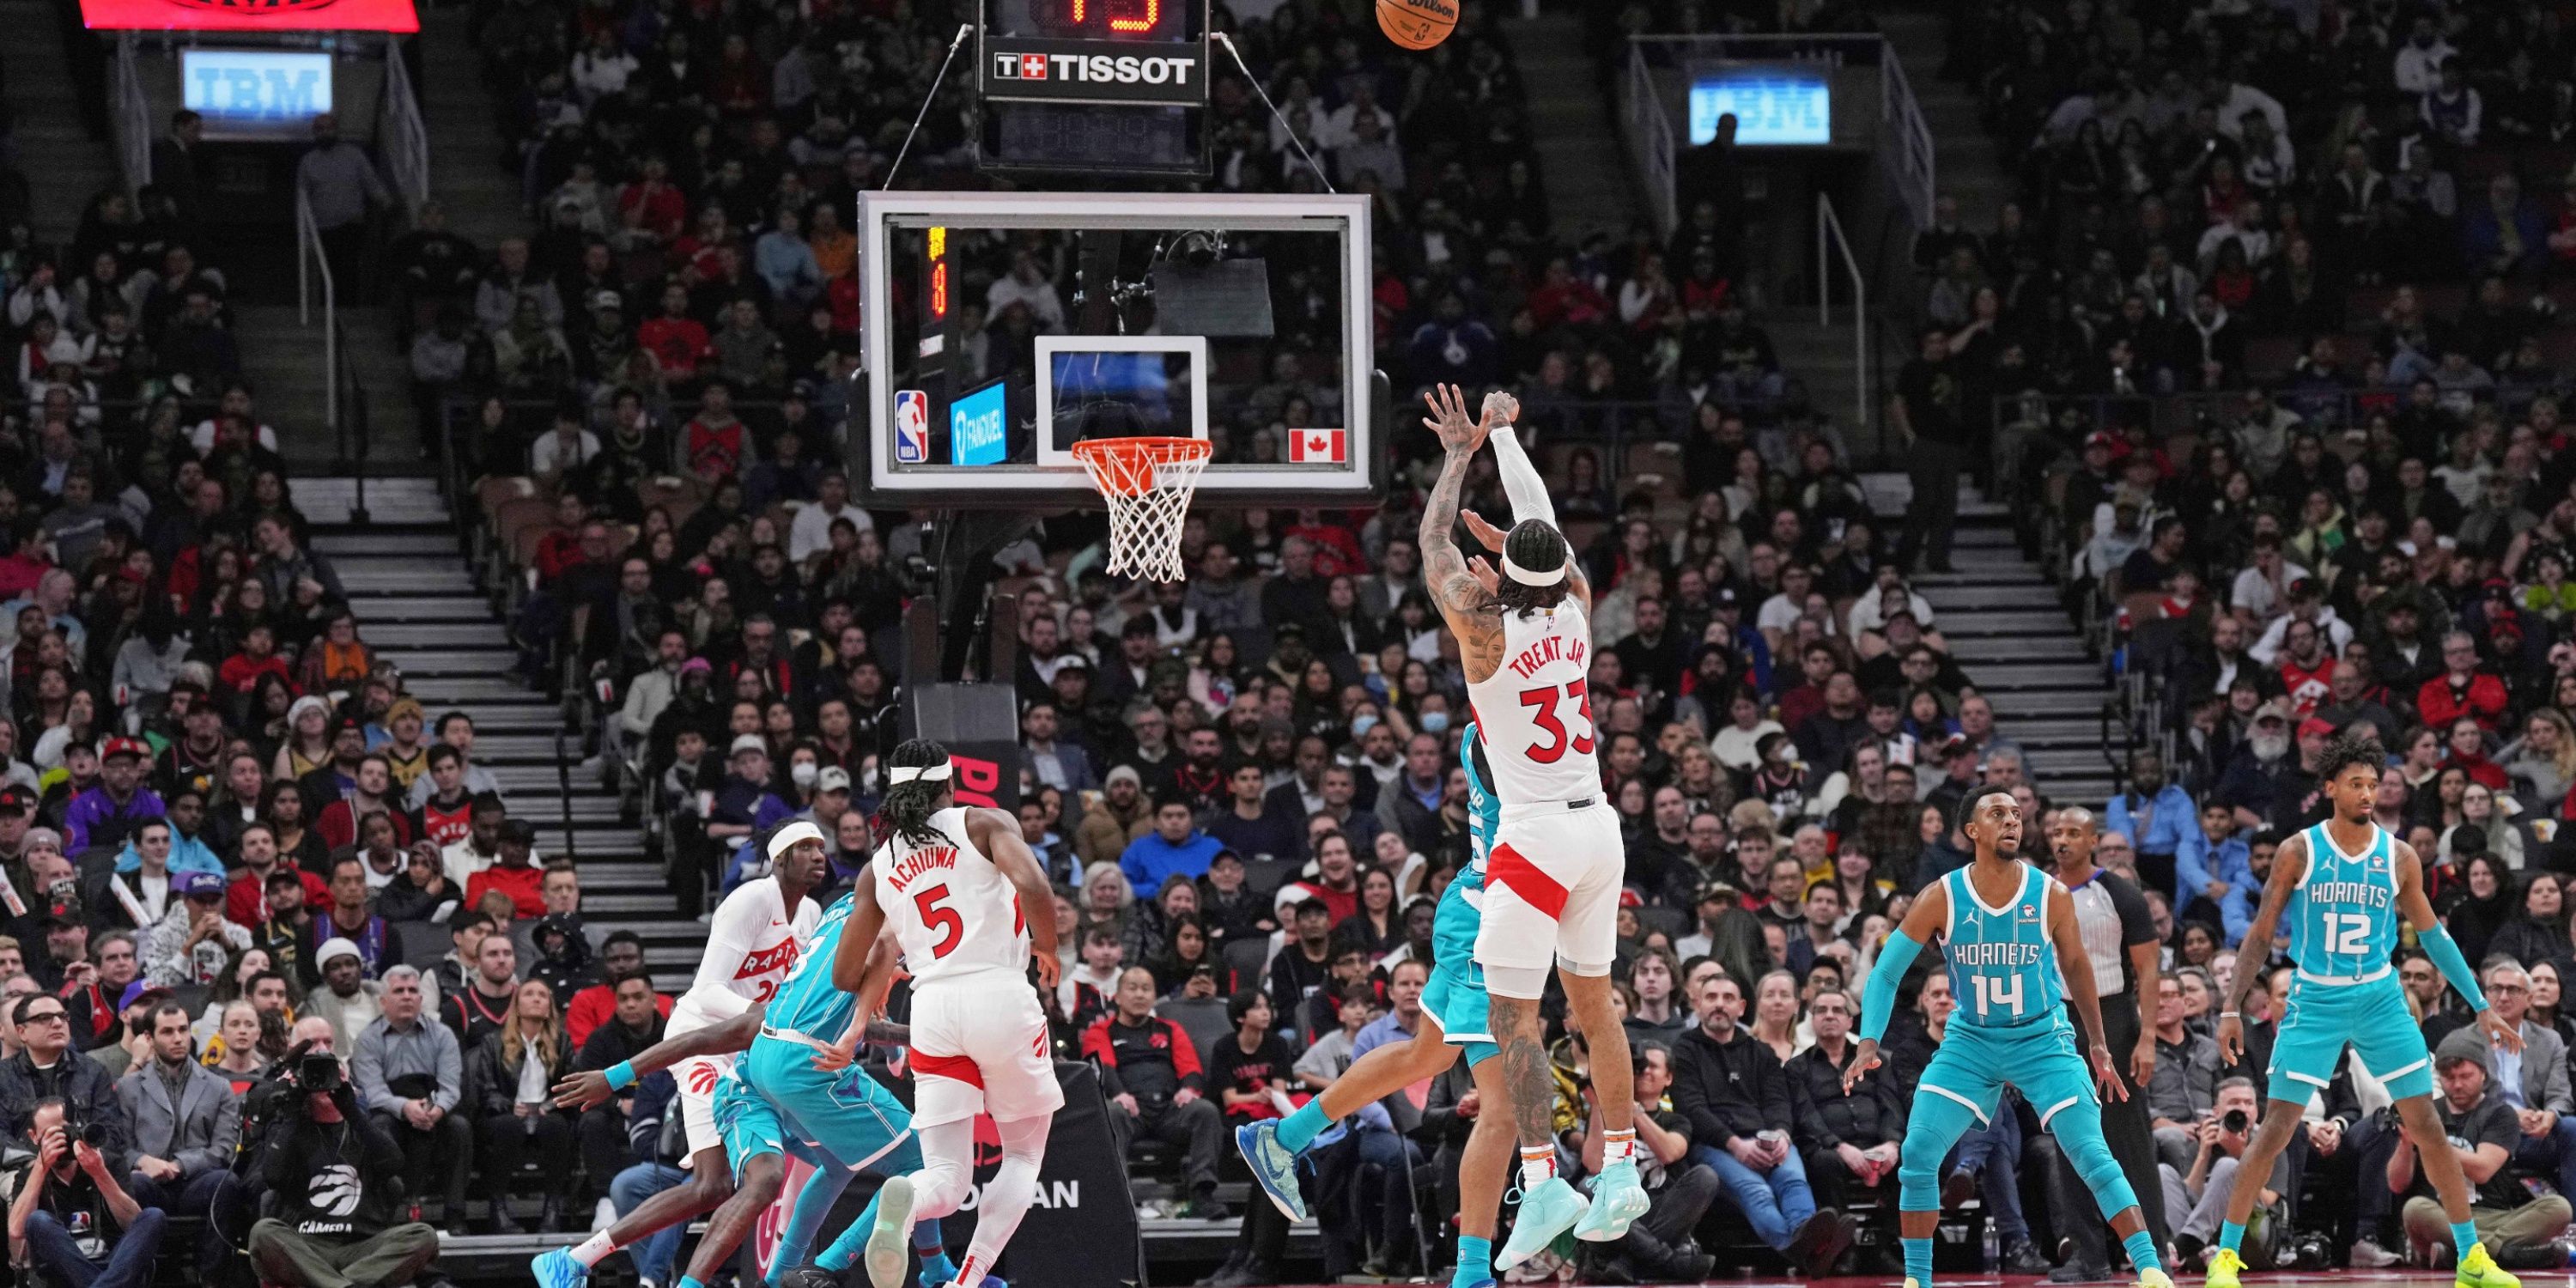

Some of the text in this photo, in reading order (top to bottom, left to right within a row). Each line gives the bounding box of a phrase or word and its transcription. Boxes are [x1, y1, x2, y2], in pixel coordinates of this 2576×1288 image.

[1050, 54, 1194, 84] TISSOT
[195, 68, 319, 118] IBM
[900, 446, 916, 458] NBA
[1508, 635, 1561, 679] TRENT
[1519, 677, 1595, 764] 33
[888, 847, 957, 893] ACHIUWA
[2311, 881, 2388, 908] HORNETS
[914, 882, 963, 960] 5
[2323, 912, 2372, 955] 12
[1954, 942, 2040, 965] HORNETS
[1971, 973, 2024, 1016] 14
